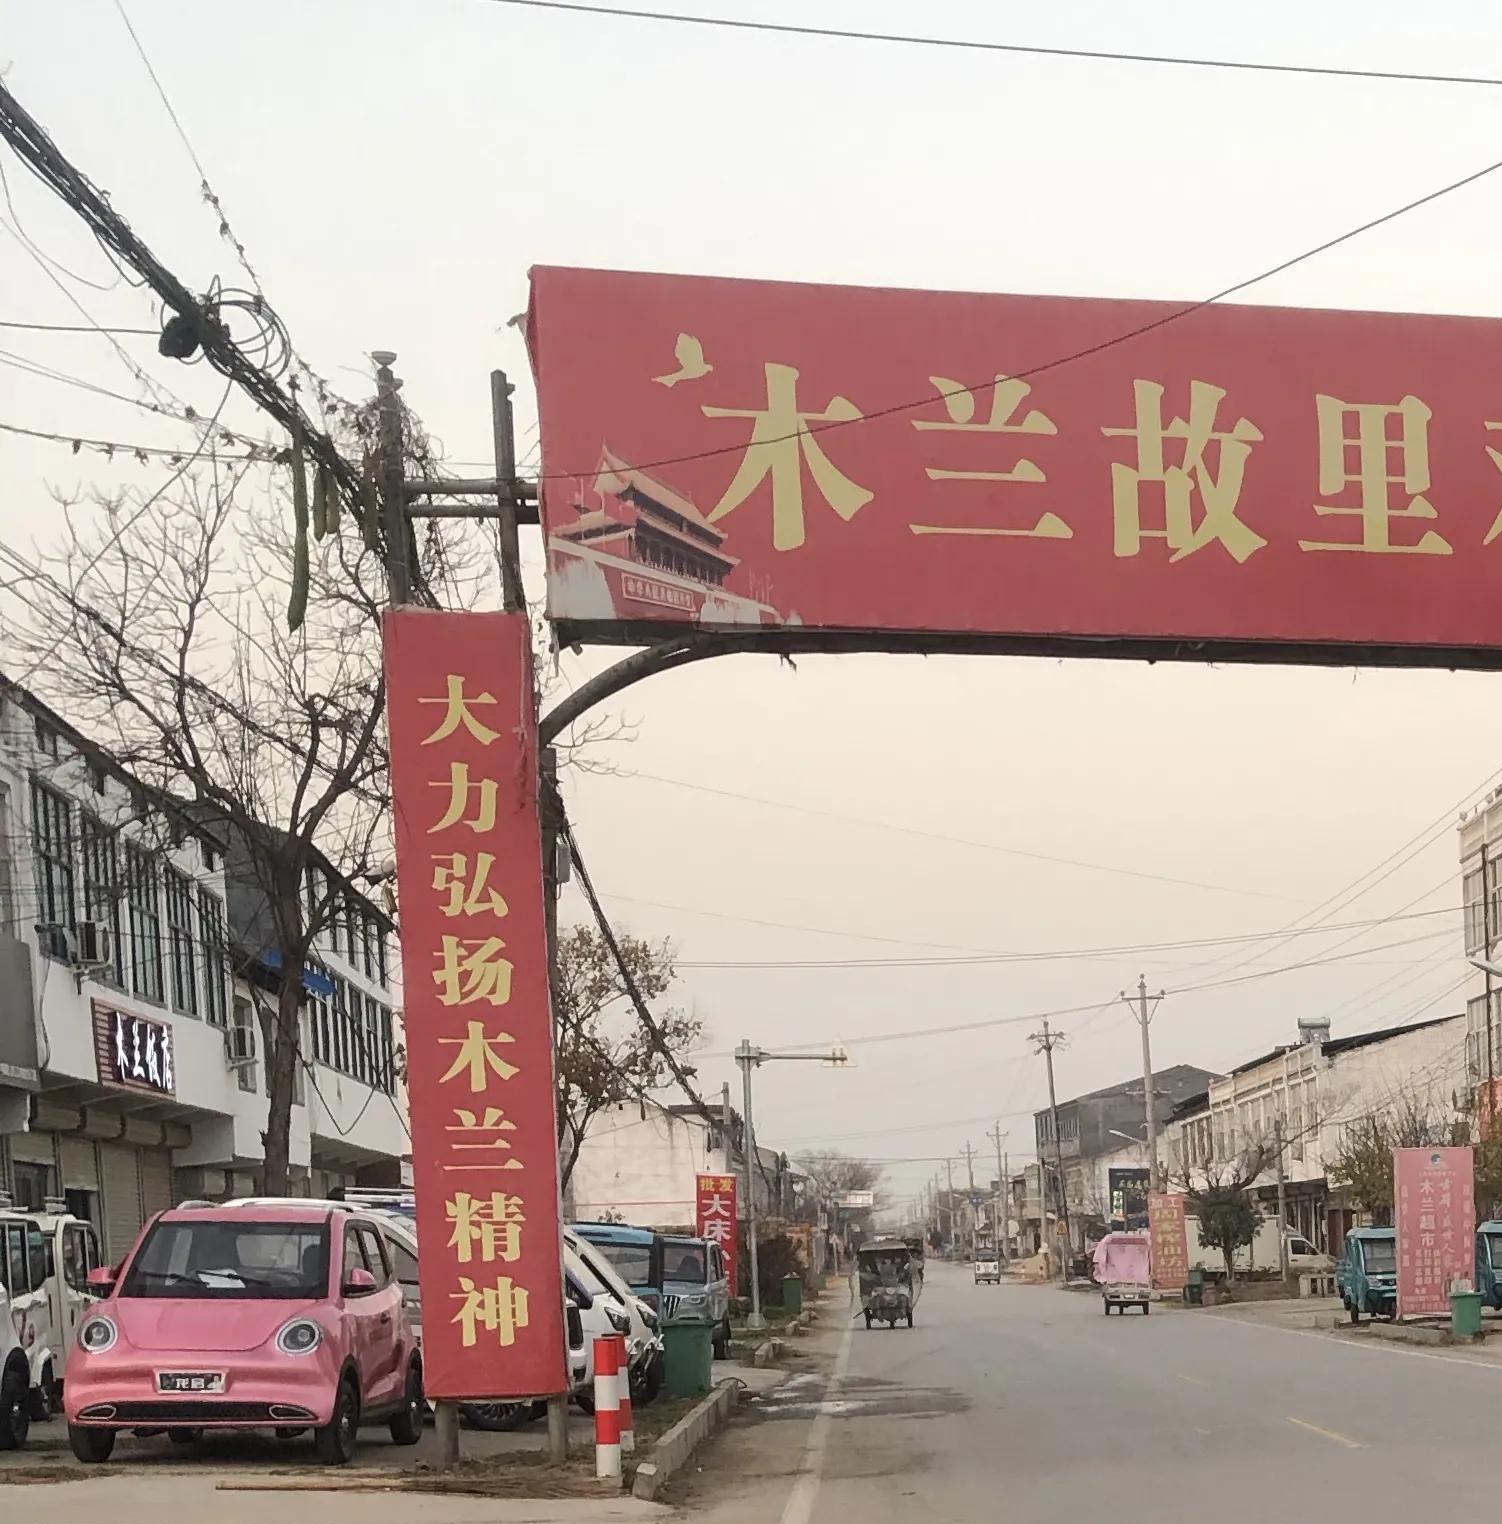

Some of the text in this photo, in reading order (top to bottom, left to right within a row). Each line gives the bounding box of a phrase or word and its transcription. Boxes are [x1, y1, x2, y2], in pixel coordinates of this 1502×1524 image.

[417, 674, 529, 1348] 大力弘扬木兰精神
[701, 1178, 734, 1193] 批发
[1419, 1179, 1436, 1246] 木兰超市
